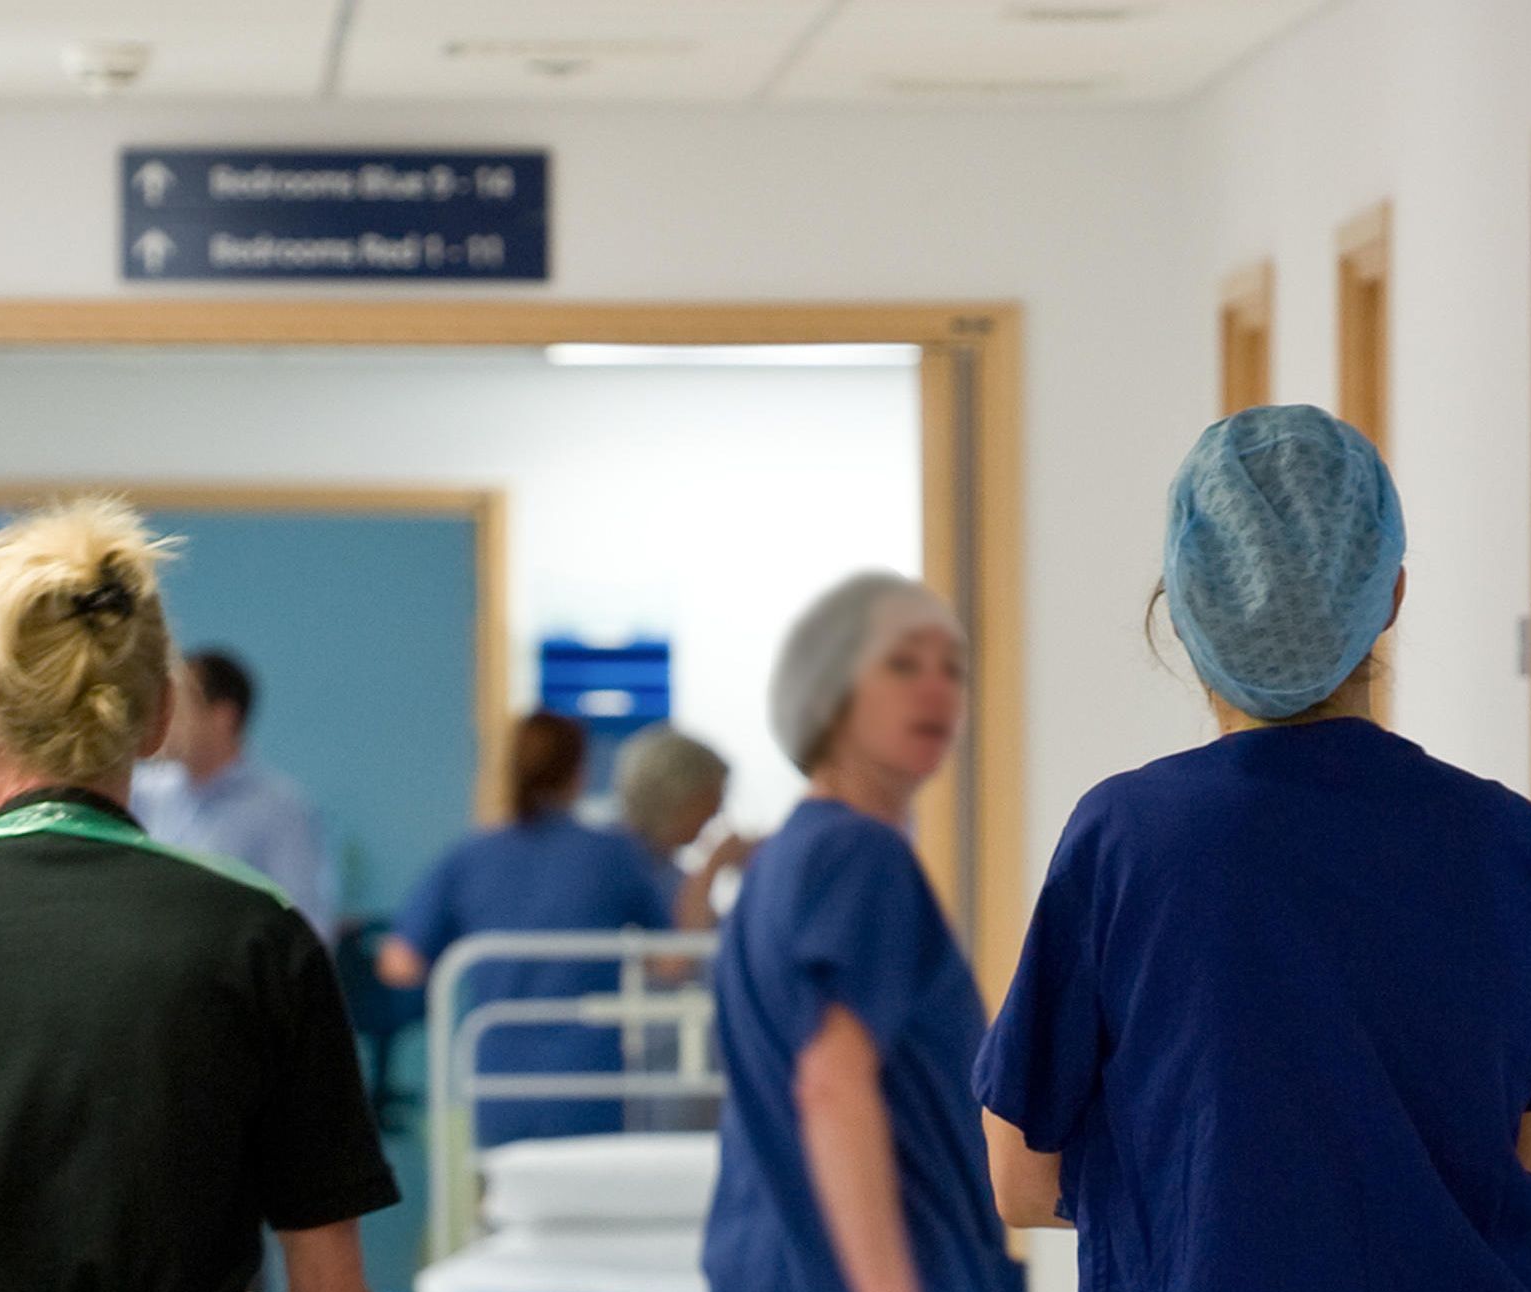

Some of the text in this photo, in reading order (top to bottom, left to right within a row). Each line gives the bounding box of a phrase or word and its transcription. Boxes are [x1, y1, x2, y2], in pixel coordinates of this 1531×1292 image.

[210, 165, 354, 198] Bedrooms
[359, 165, 425, 198] Blue
[210, 234, 354, 268] Bedrooms
[359, 233, 420, 268] Red
